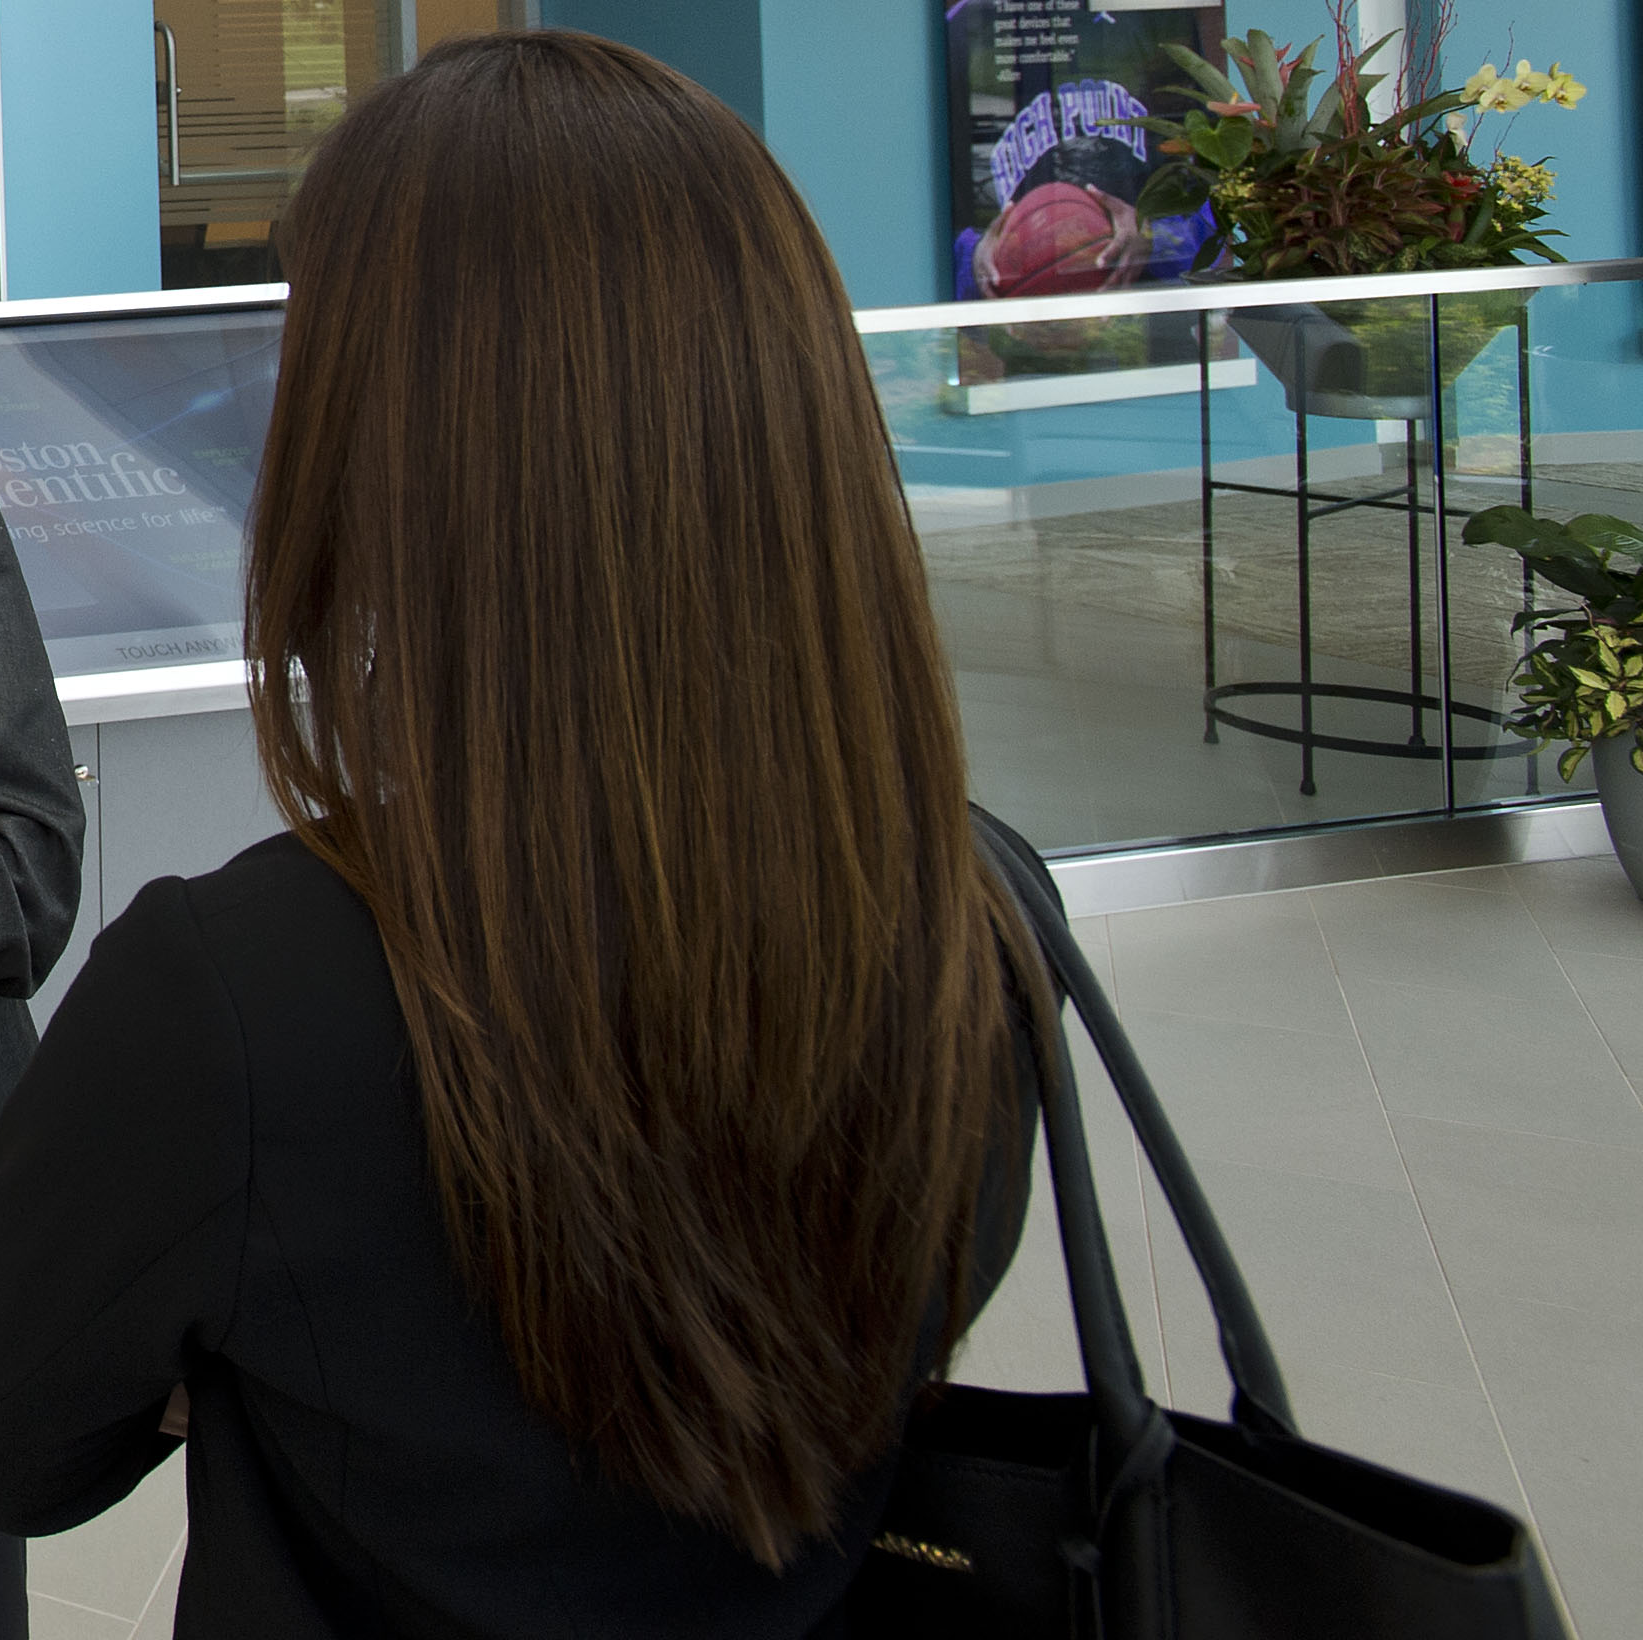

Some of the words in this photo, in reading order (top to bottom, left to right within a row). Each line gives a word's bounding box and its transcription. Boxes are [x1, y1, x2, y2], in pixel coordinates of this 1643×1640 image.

[990, 89, 1059, 213] HIGH
[1058, 78, 1148, 162] POINT
[54, 517, 138, 536] science
[142, 512, 174, 529] for
[116, 642, 182, 660] TOUCH
